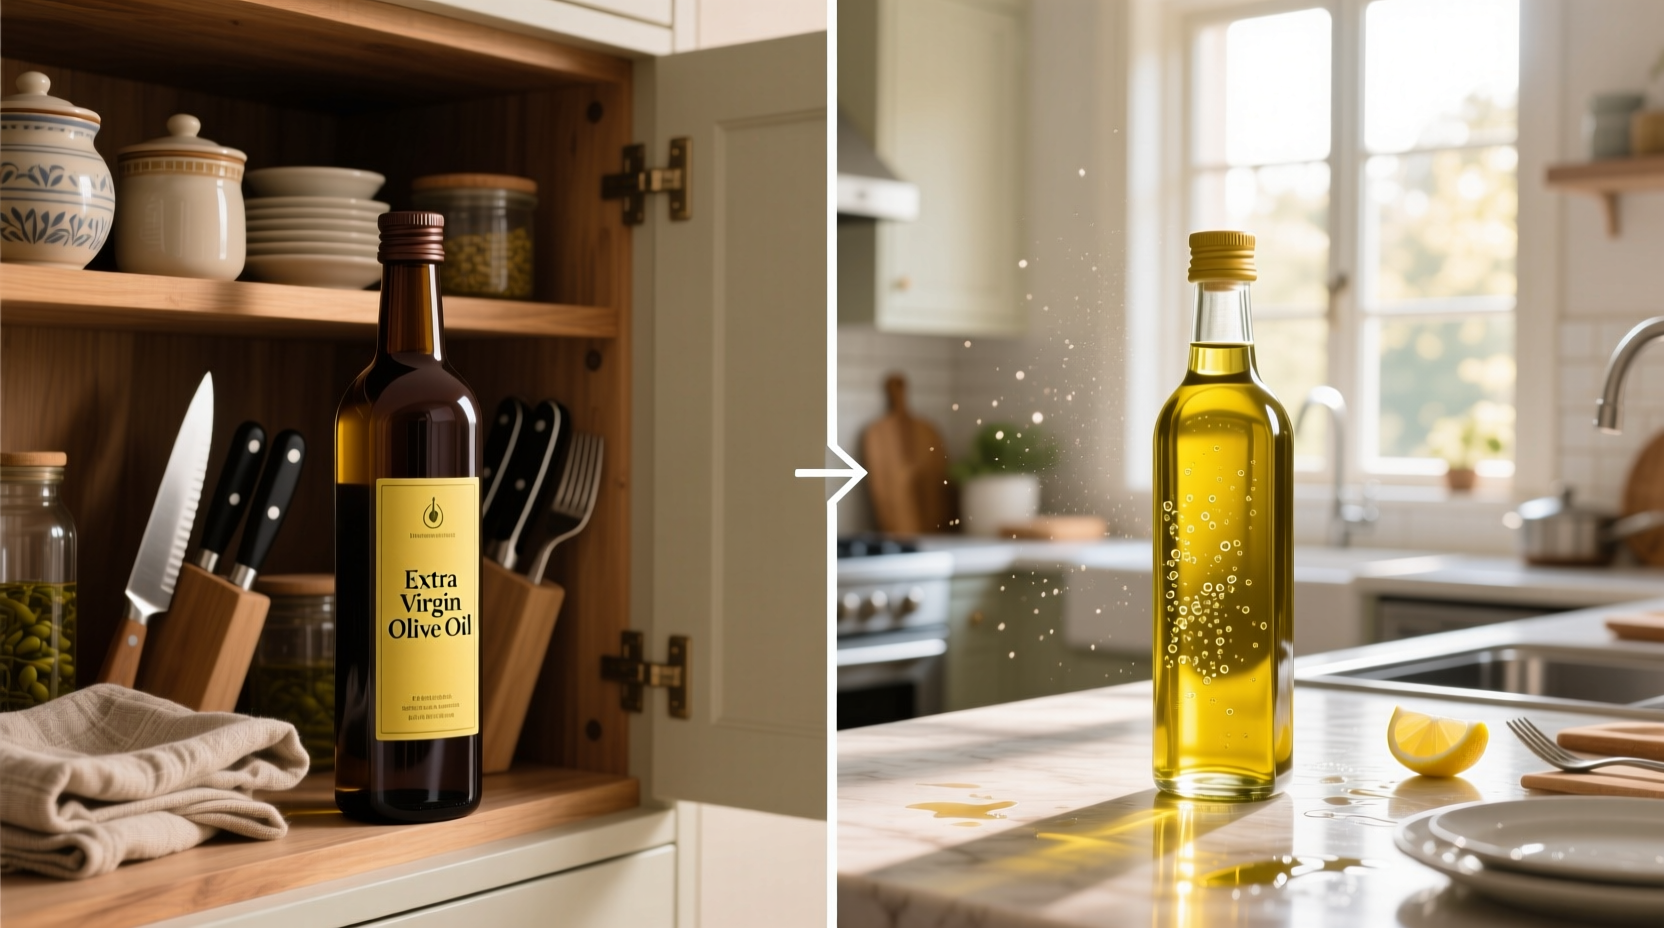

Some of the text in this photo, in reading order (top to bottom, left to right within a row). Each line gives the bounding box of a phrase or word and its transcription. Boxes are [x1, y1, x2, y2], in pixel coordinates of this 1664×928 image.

[405, 570, 457, 589] Extra
[400, 592, 462, 618] Virgin
[388, 614, 471, 639] Olive Oil
